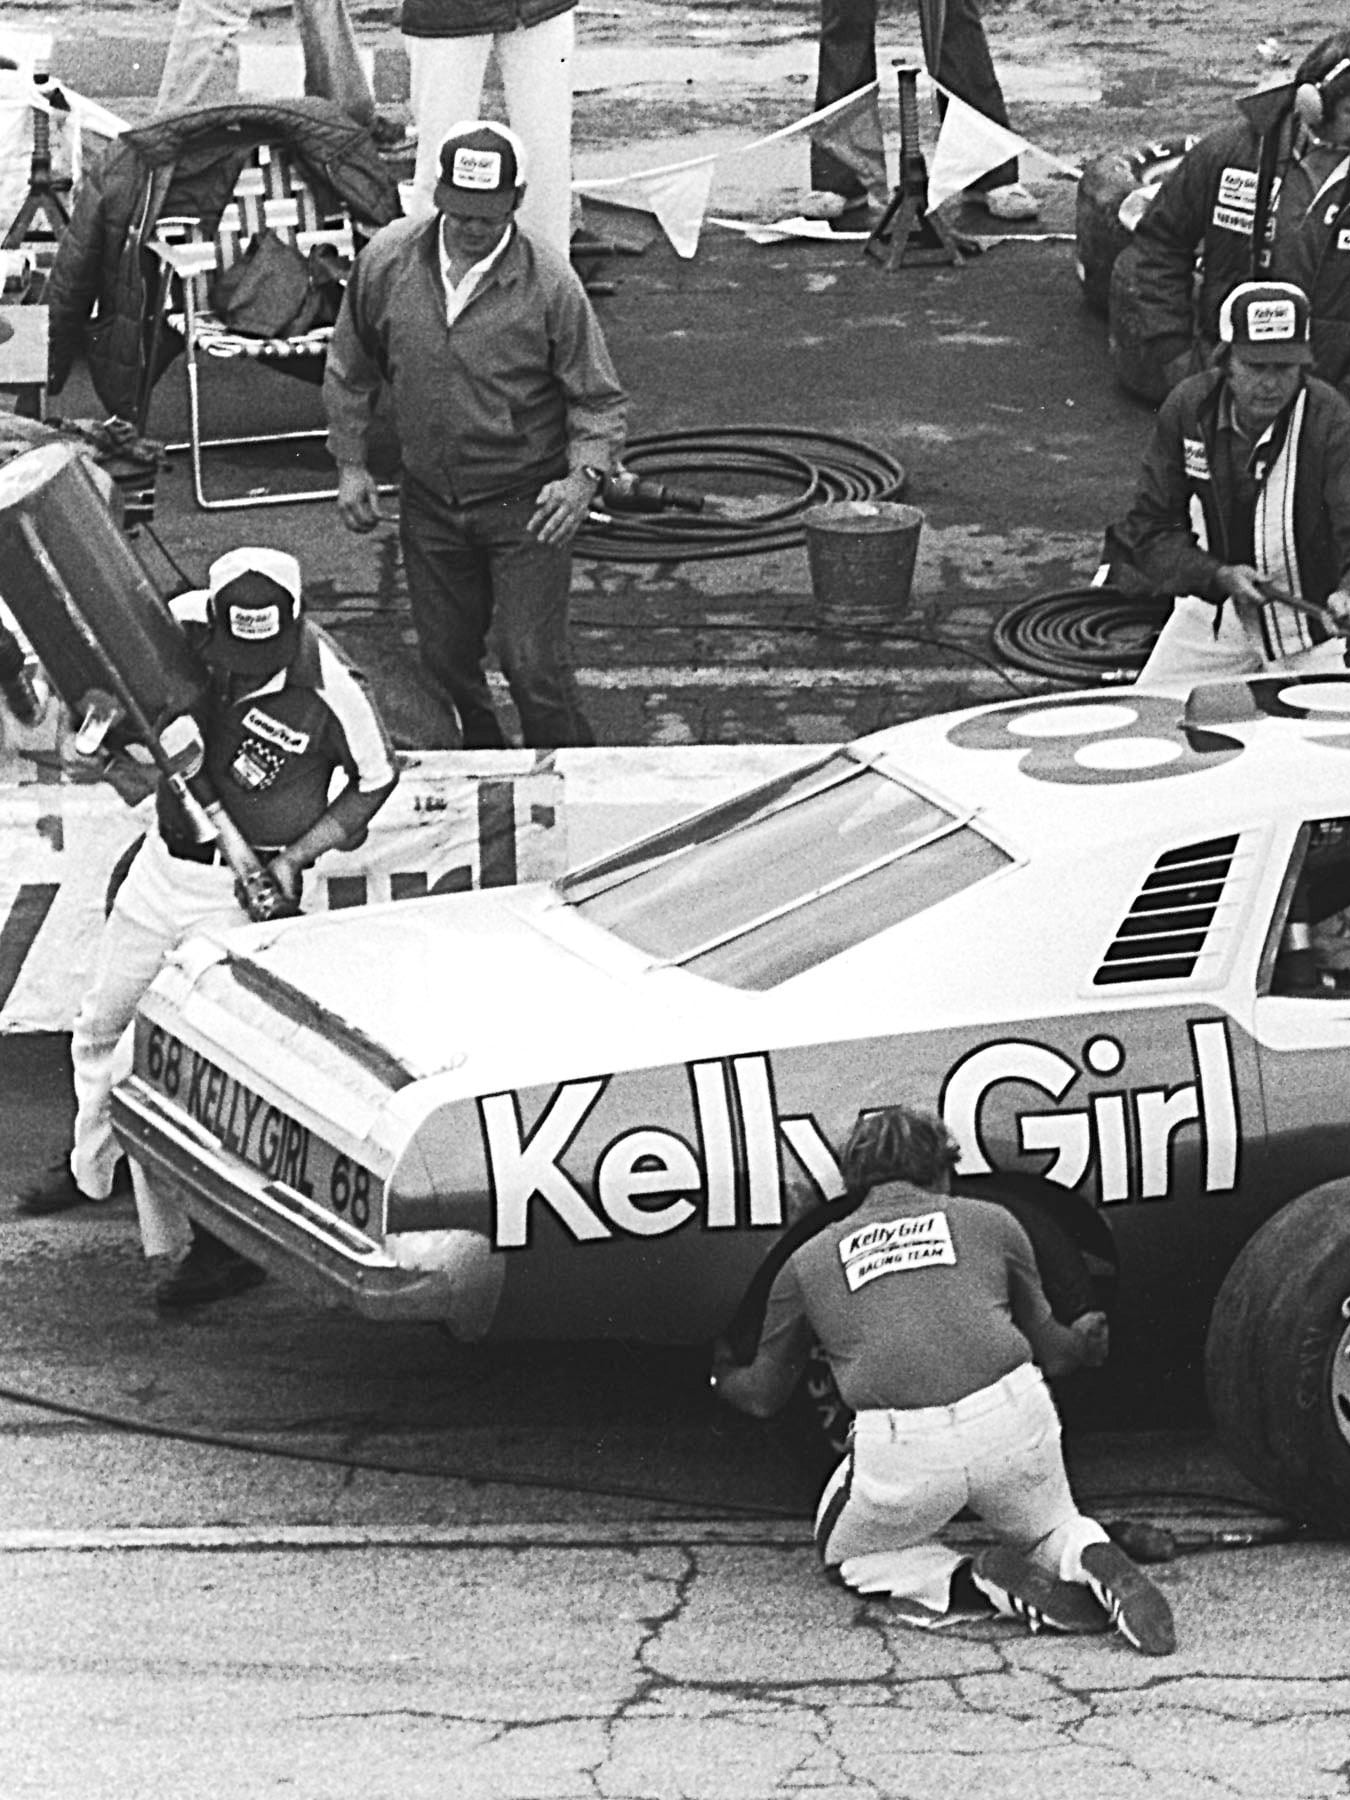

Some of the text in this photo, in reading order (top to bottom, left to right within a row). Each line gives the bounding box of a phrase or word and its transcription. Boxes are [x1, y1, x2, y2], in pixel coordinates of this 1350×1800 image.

[150, 1024, 182, 1098] 68
[331, 1153, 370, 1230] 68
[938, 1018, 1241, 1204] Girl
[858, 1254, 902, 1278] RACING
